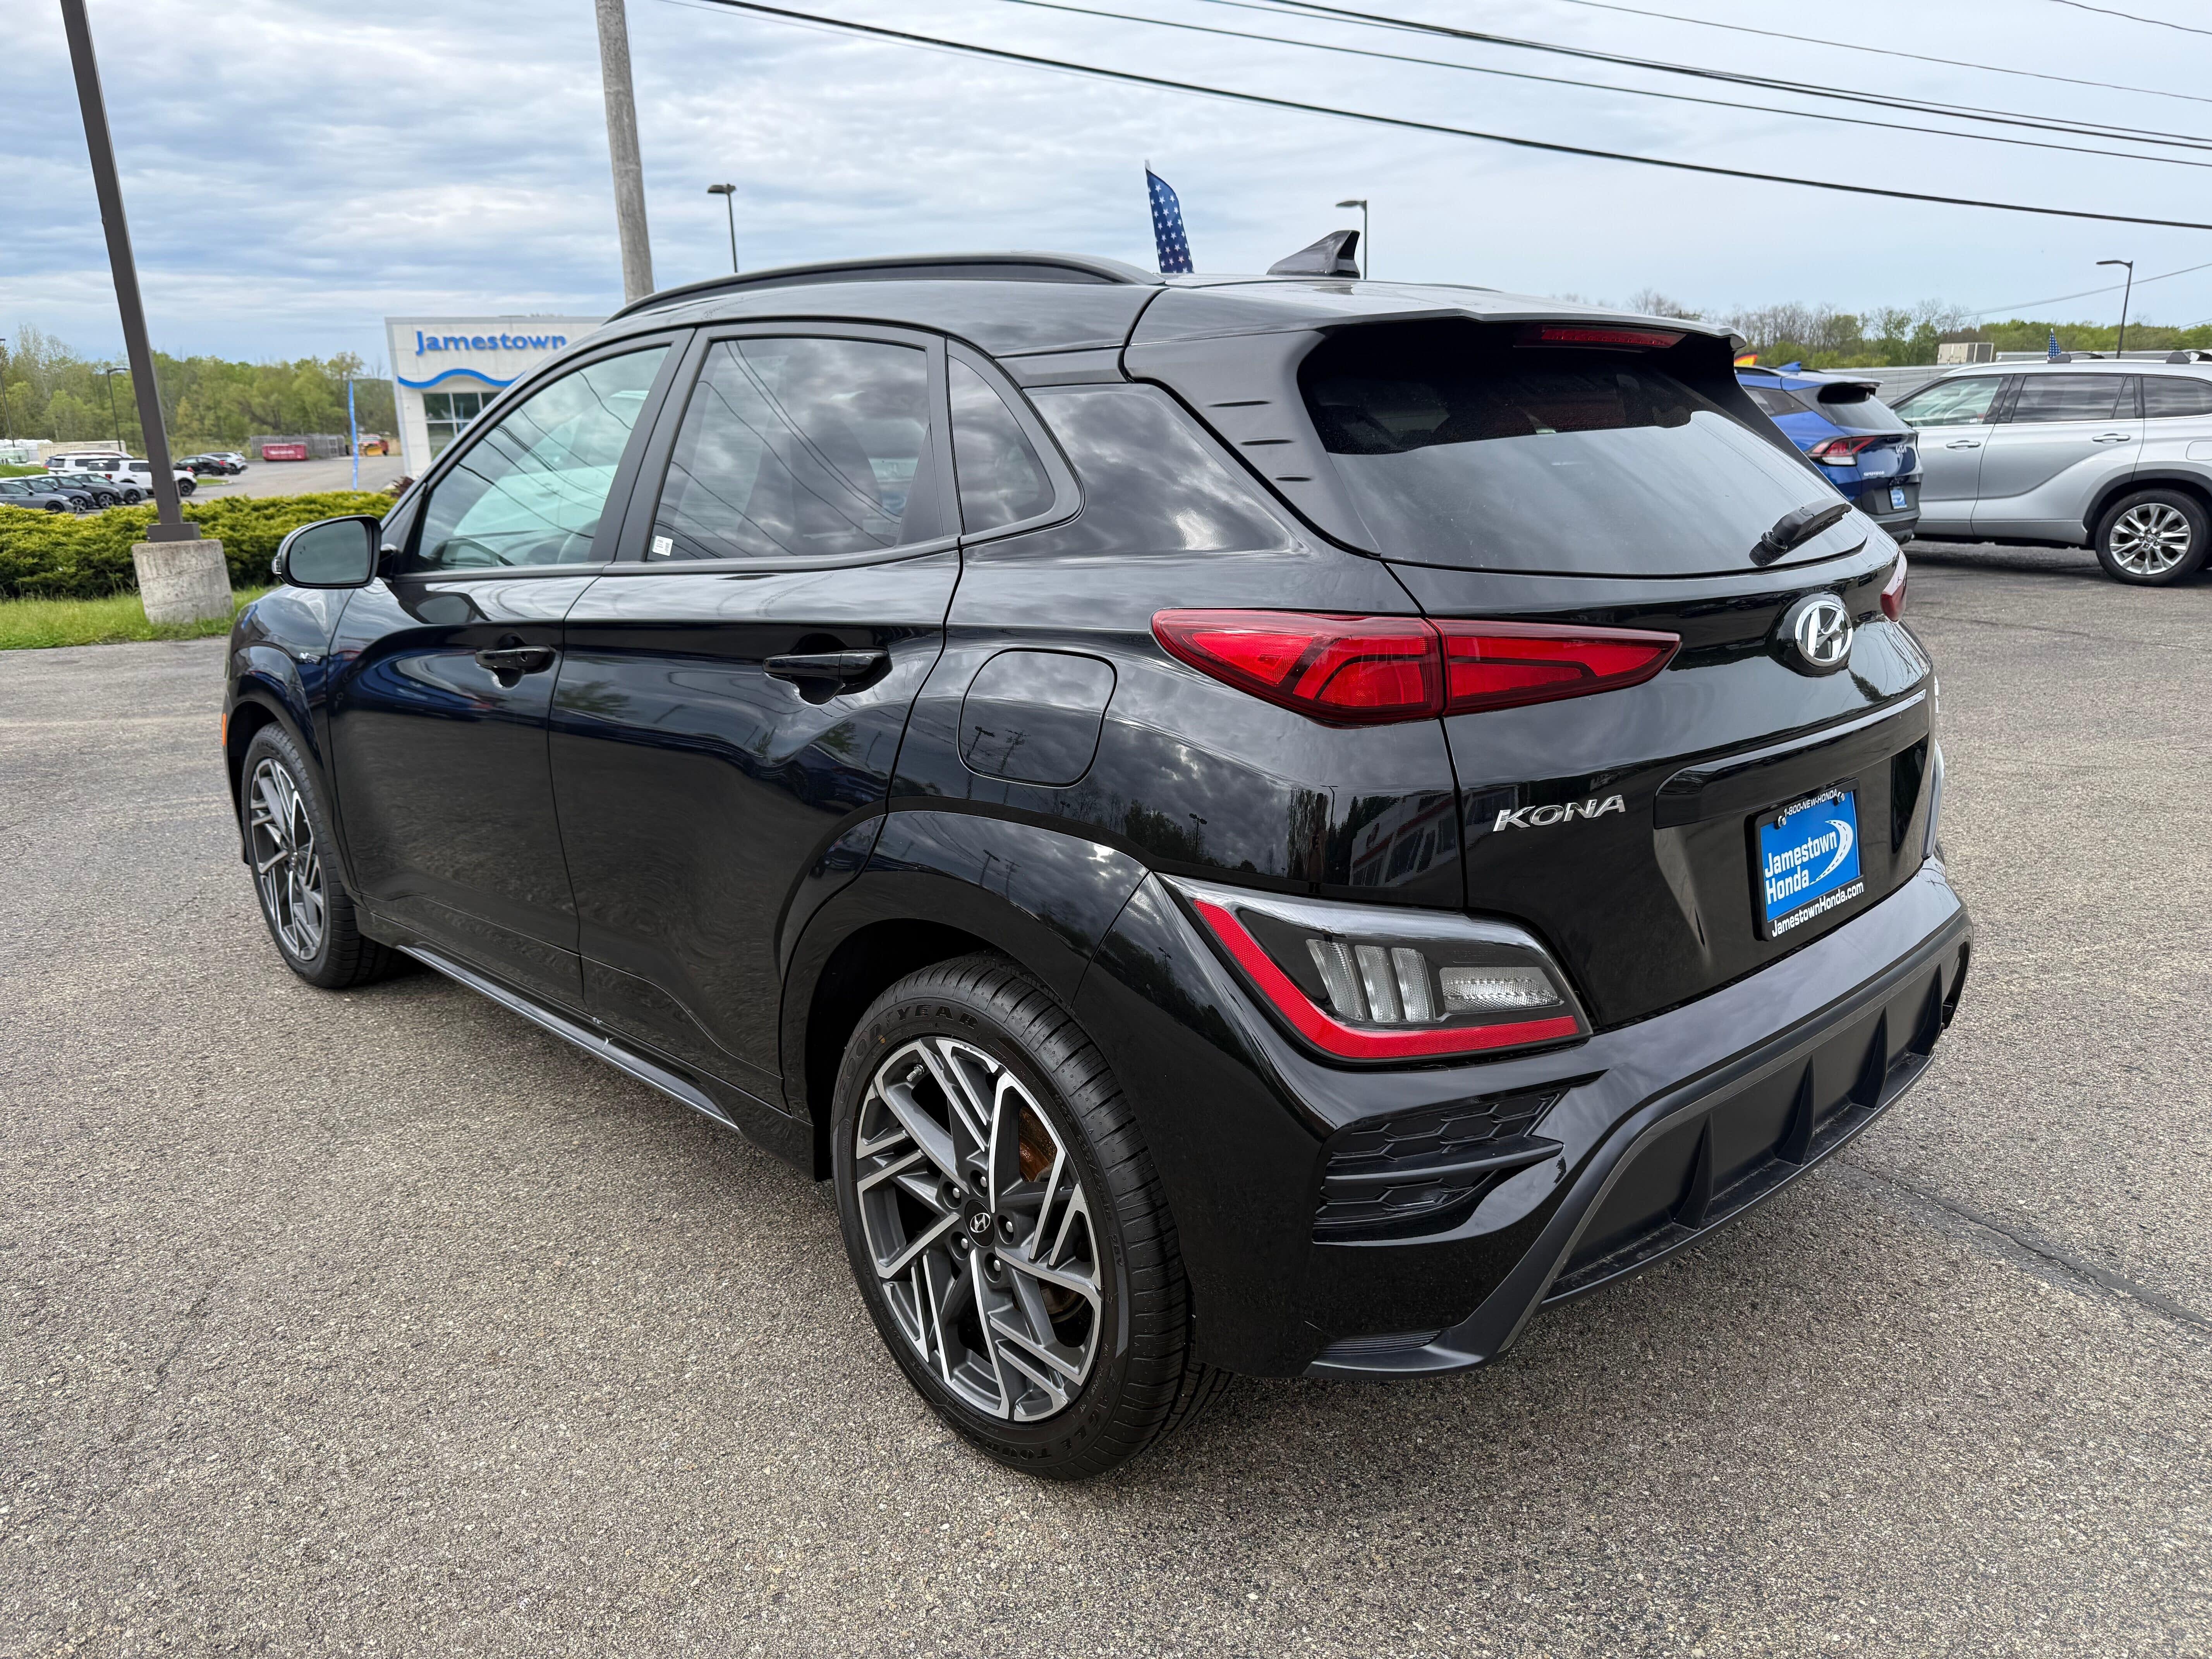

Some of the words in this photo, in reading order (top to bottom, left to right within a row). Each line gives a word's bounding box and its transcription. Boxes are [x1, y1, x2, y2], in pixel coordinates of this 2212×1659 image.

[415, 331, 567, 356] Jamestown
[1492, 794, 1626, 832] KONA
[1784, 788, 1838, 817] 1-800-NEW-HONDA
[1764, 831, 1838, 878] Jamestown
[1765, 866, 1810, 905] Honda
[1772, 881, 1864, 938] JamestownHonda.com
[838, 1004, 979, 1104] GOODYEAR
[1060, 1363, 1119, 1453] EAGLE
[940, 1408, 1052, 1460] TOURING
